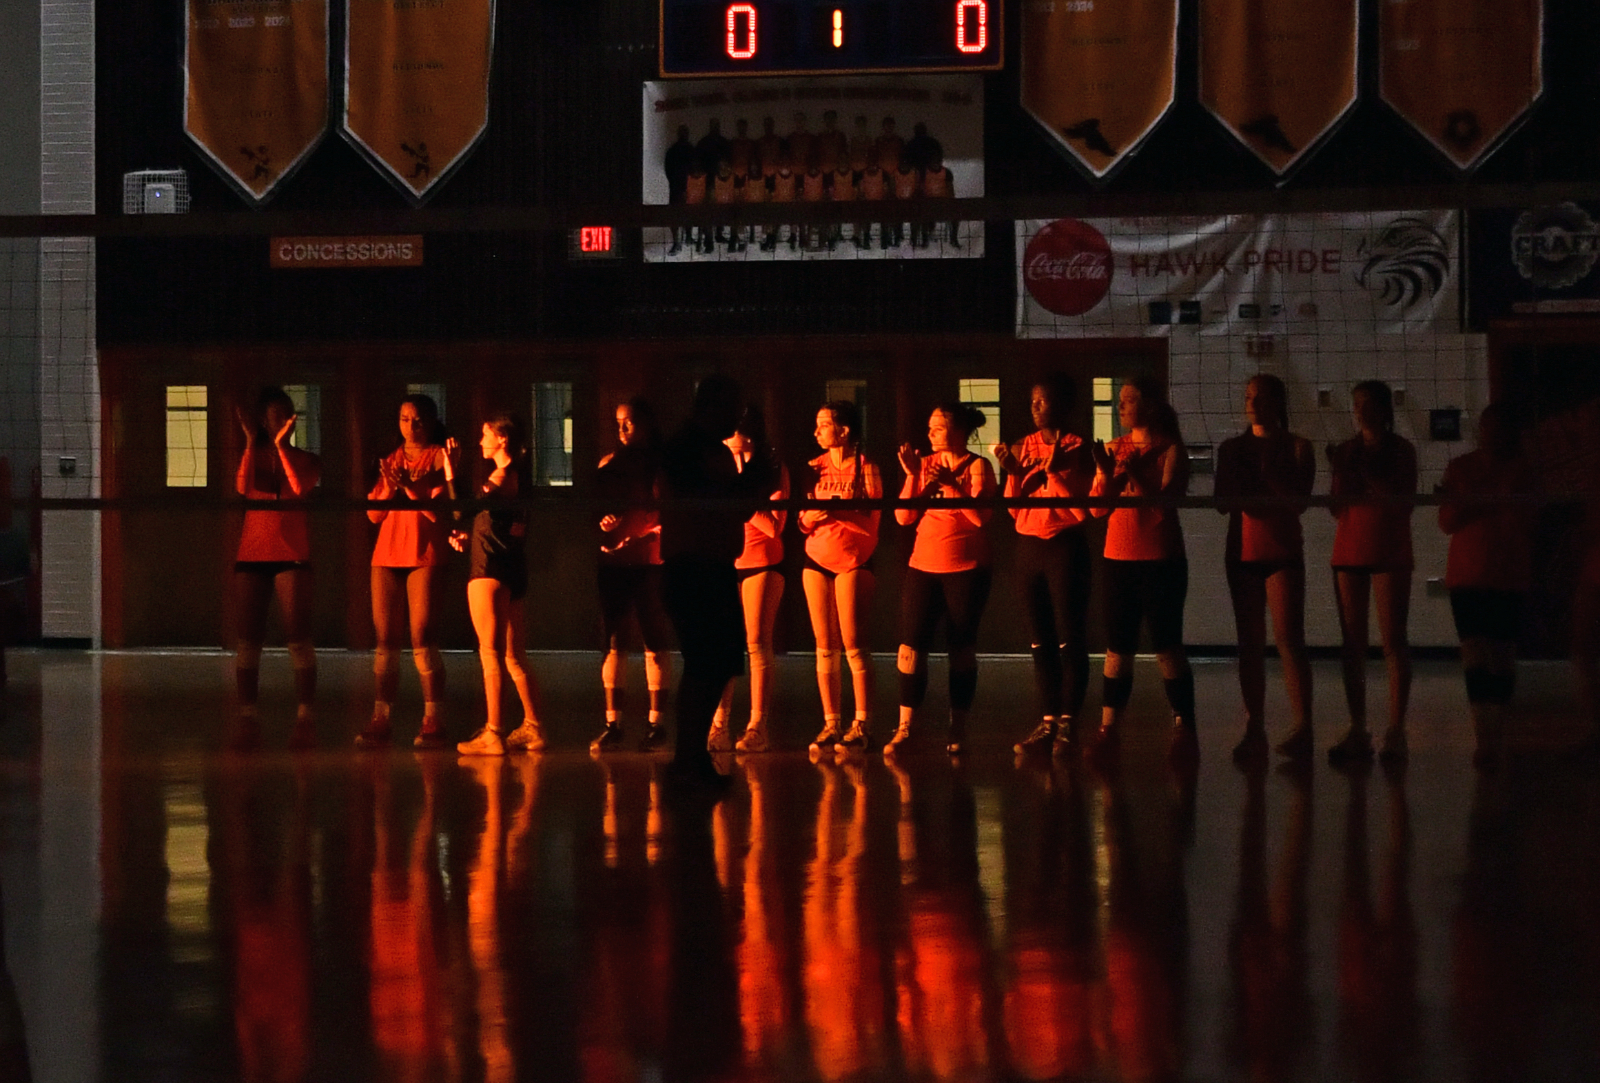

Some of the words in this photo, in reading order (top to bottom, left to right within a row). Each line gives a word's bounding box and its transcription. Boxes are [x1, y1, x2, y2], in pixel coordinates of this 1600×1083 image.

[727, 4, 756, 59] 0
[832, 9, 843, 48] 1
[956, 0, 986, 53] 0
[279, 243, 413, 261] CONCESSIONS
[581, 226, 612, 251] EXIT
[1130, 252, 1231, 277] HAWK
[1244, 249, 1341, 275] PRIDE
